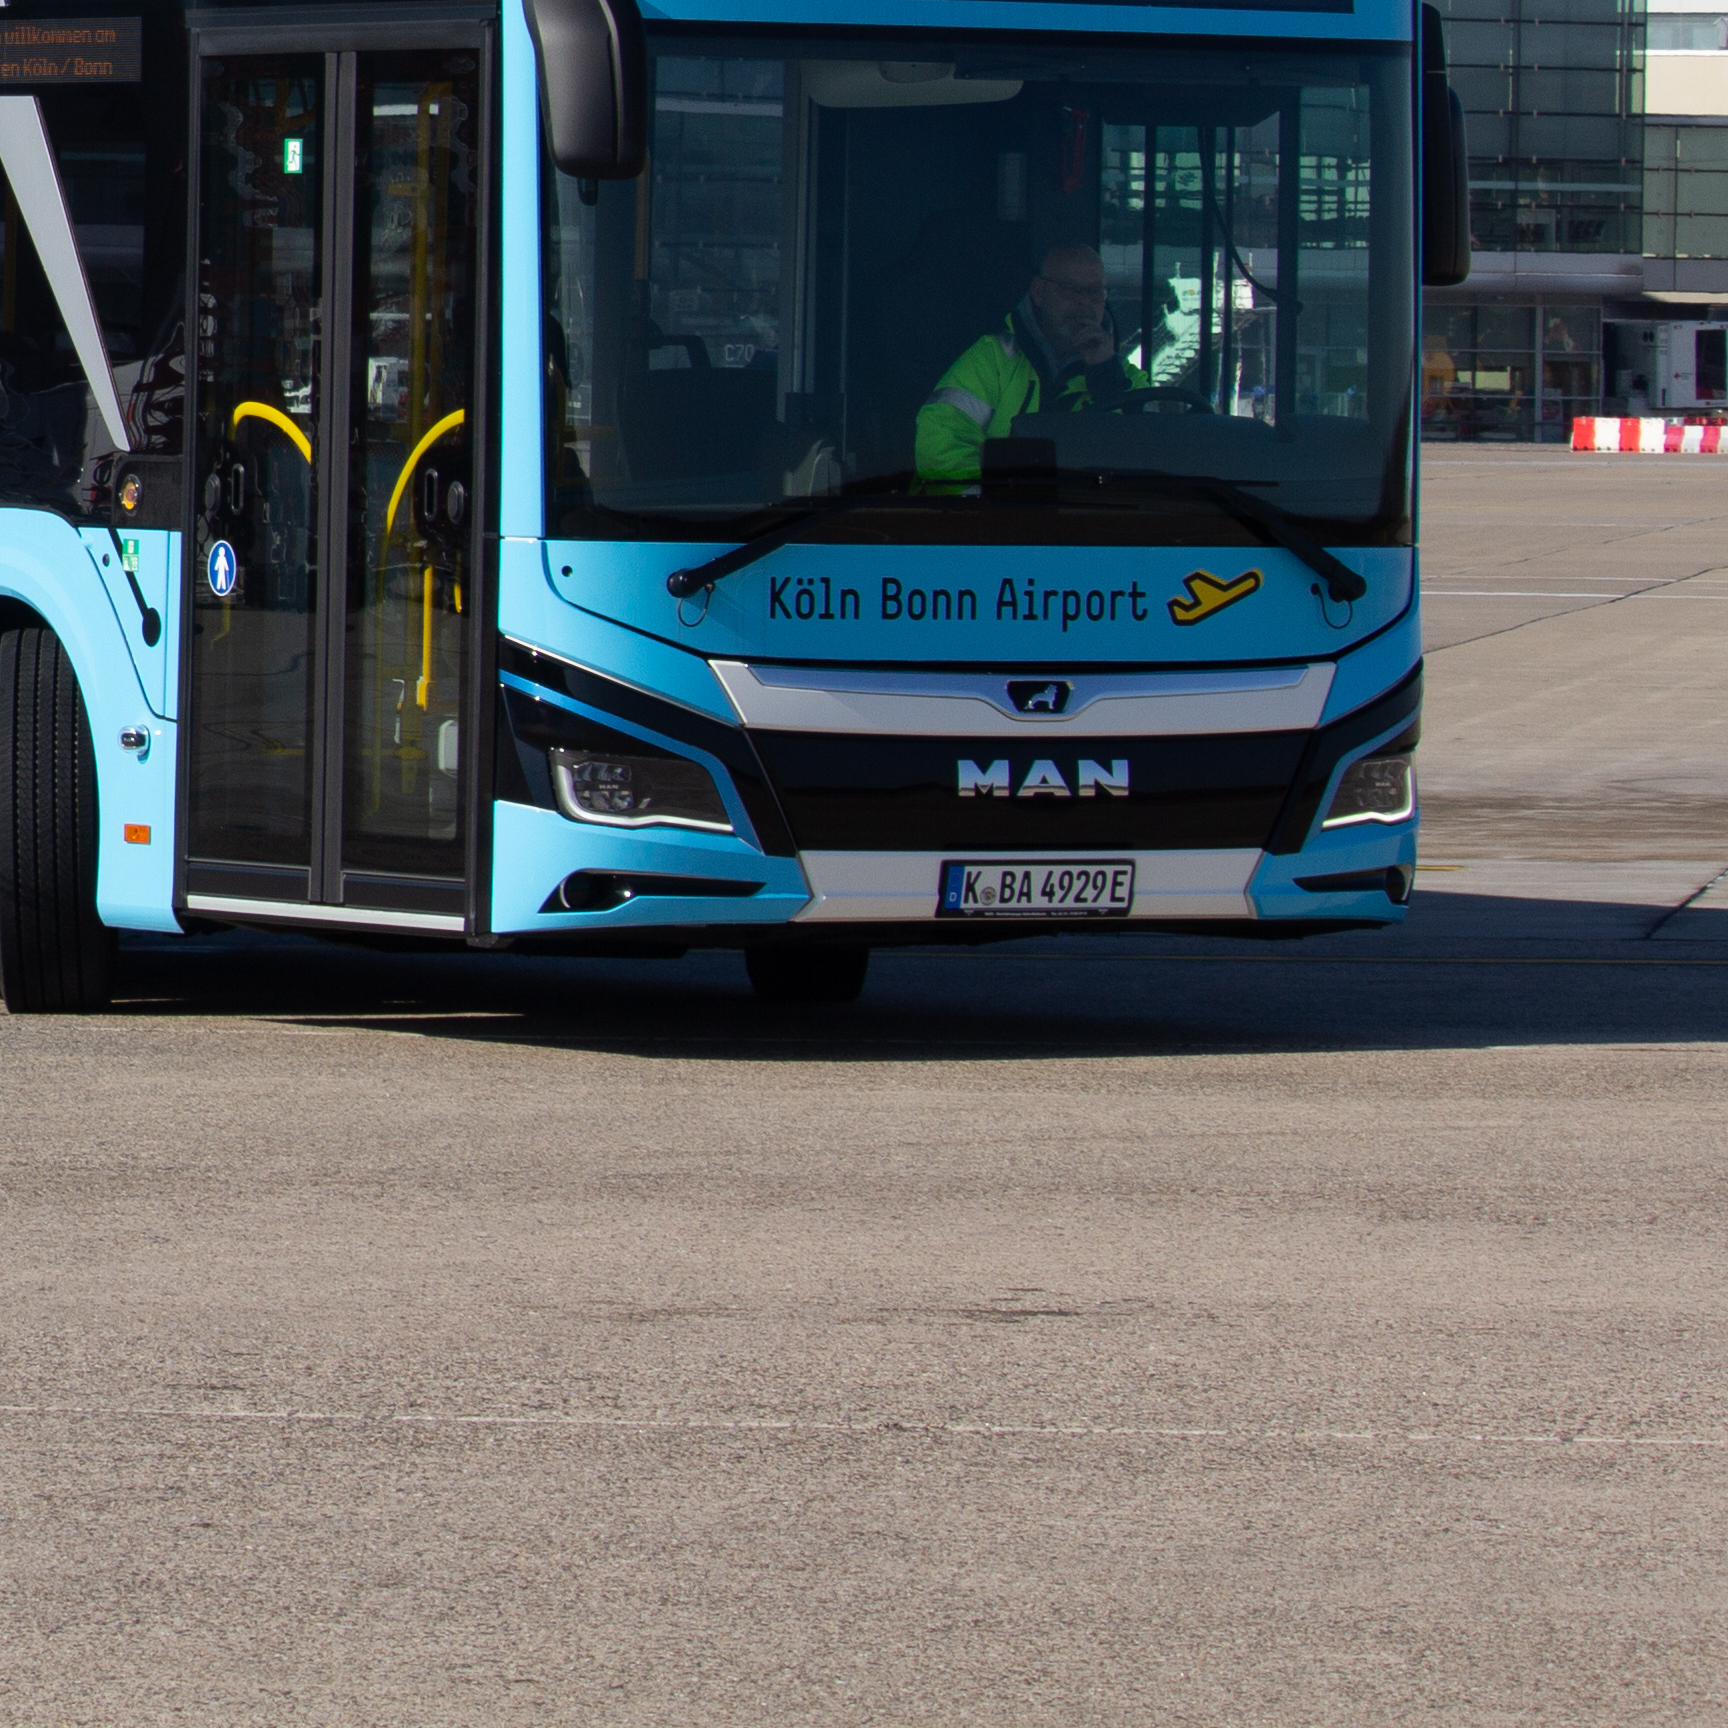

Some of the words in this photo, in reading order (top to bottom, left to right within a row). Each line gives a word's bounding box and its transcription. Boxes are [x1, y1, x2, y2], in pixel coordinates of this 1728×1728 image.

[4, 26, 92, 45] willkommen
[95, 29, 117, 43] am
[23, 57, 59, 76] Köln
[73, 57, 113, 75] Bonn
[769, 576, 860, 621] Köln
[881, 576, 977, 621] Bonn
[996, 577, 1148, 633] Airport
[957, 759, 1129, 796] MAN
[949, 892, 957, 903] D
[963, 870, 982, 904] K
[999, 870, 1032, 904] BA
[1041, 869, 1129, 904] 4929E
